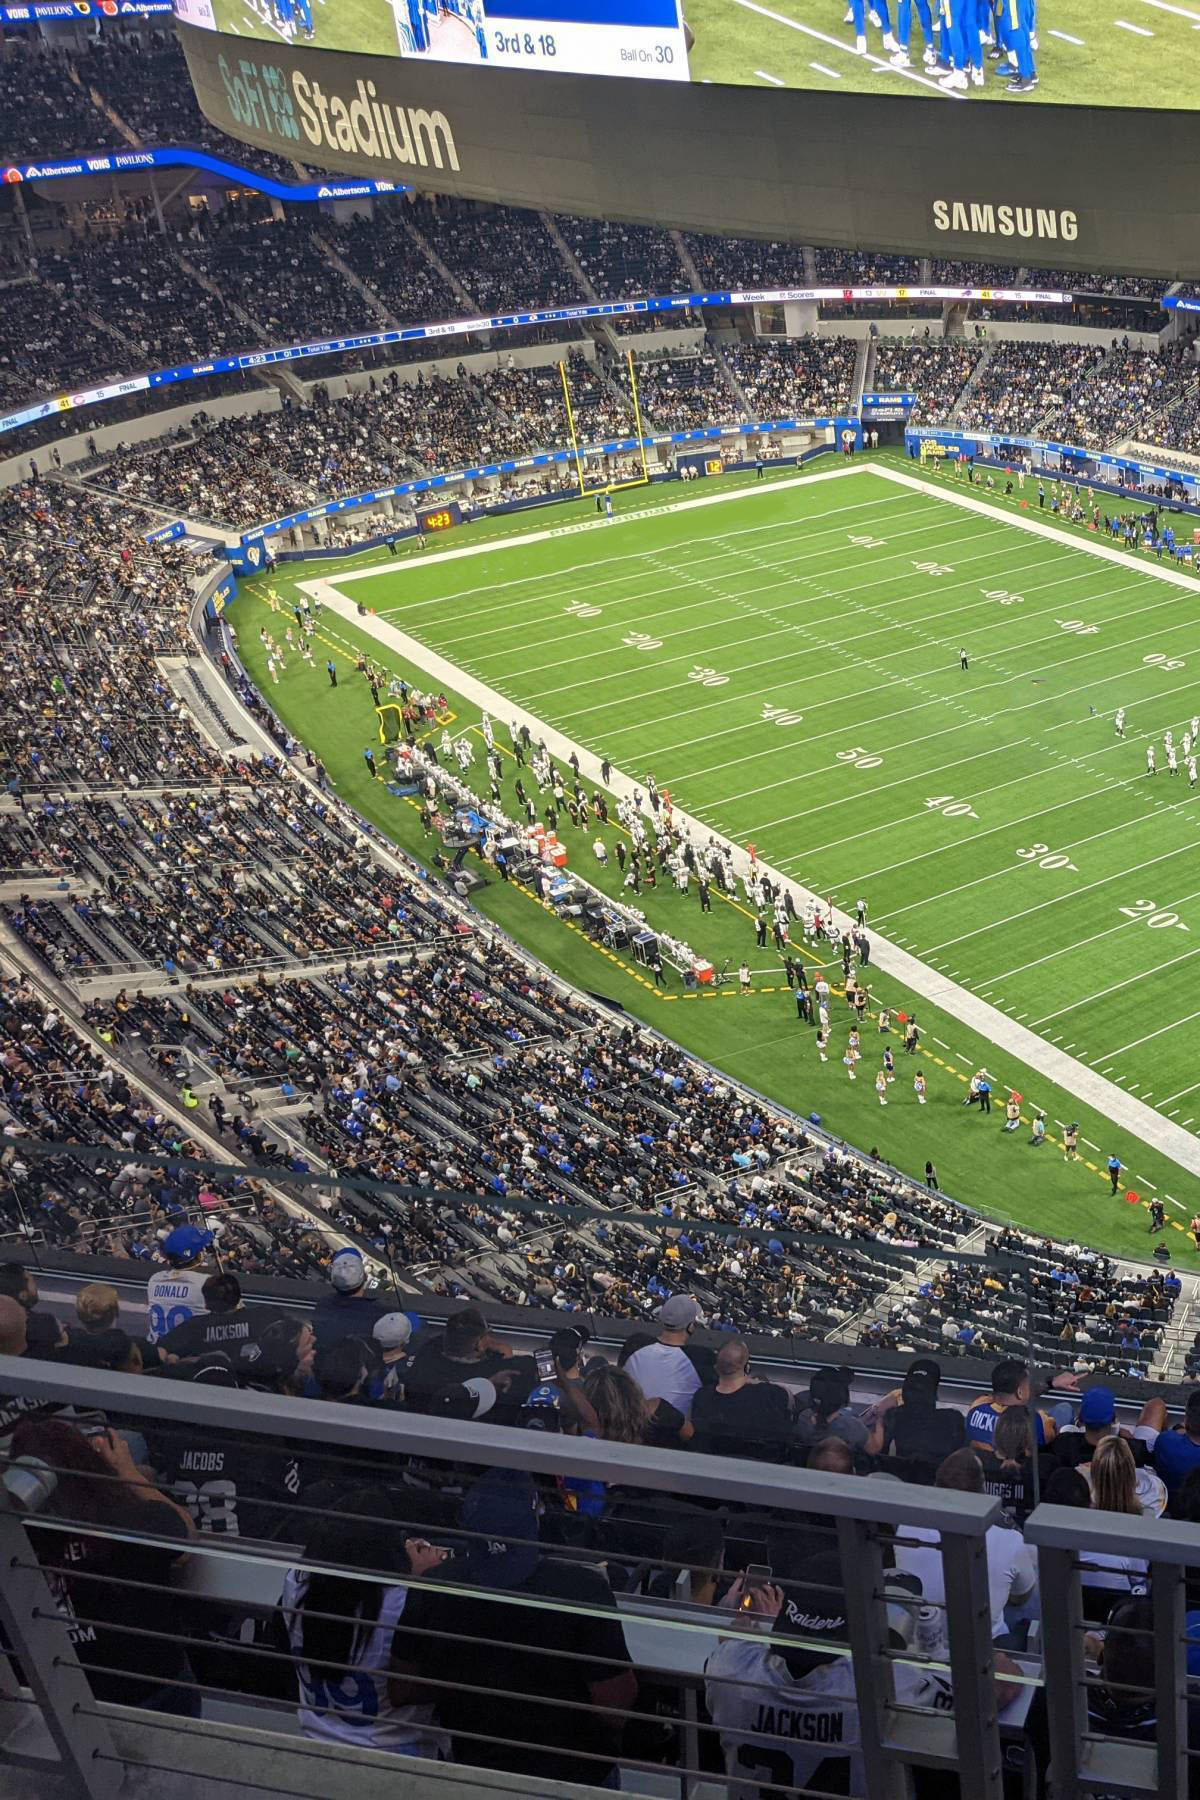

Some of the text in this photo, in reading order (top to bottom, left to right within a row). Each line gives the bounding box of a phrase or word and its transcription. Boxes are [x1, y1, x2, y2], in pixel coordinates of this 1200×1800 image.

[7, 8, 29, 19] VONS
[35, 5, 73, 17] PAVILIONS
[135, 4, 172, 13] Albertsons
[494, 31, 557, 57] 3rd & 18
[620, 45, 674, 64] Ball On 30
[218, 53, 461, 171] SoFi Stadium
[40, 153, 154, 176] Albertsons VONS PAVILIONS
[333, 186, 371, 196] Albertsons
[932, 199, 1078, 241] SAMSUNG
[742, 291, 815, 301] Week Scores
[919, 288, 937, 296] FINAL
[428, 327, 441, 335] 3rd
[60, 382, 137, 408] 41 15 FINAL
[2, 417, 19, 428] FINAL
[427, 512, 451, 529] 4:23
[563, 601, 602, 618] 10
[621, 632, 664, 650] 20
[1142, 653, 1186, 672] 50
[687, 667, 730, 687] 30
[759, 707, 804, 726] 40
[836, 747, 884, 769] 50
[922, 794, 973, 817] 40
[1015, 842, 1071, 870] 30
[1118, 899, 1180, 929] 20
[154, 1285, 189, 1299] DONALD
[204, 1322, 250, 1343] JACKSON
[179, 1451, 225, 1471] JACOBS
[751, 1704, 844, 1744] JACKSON
